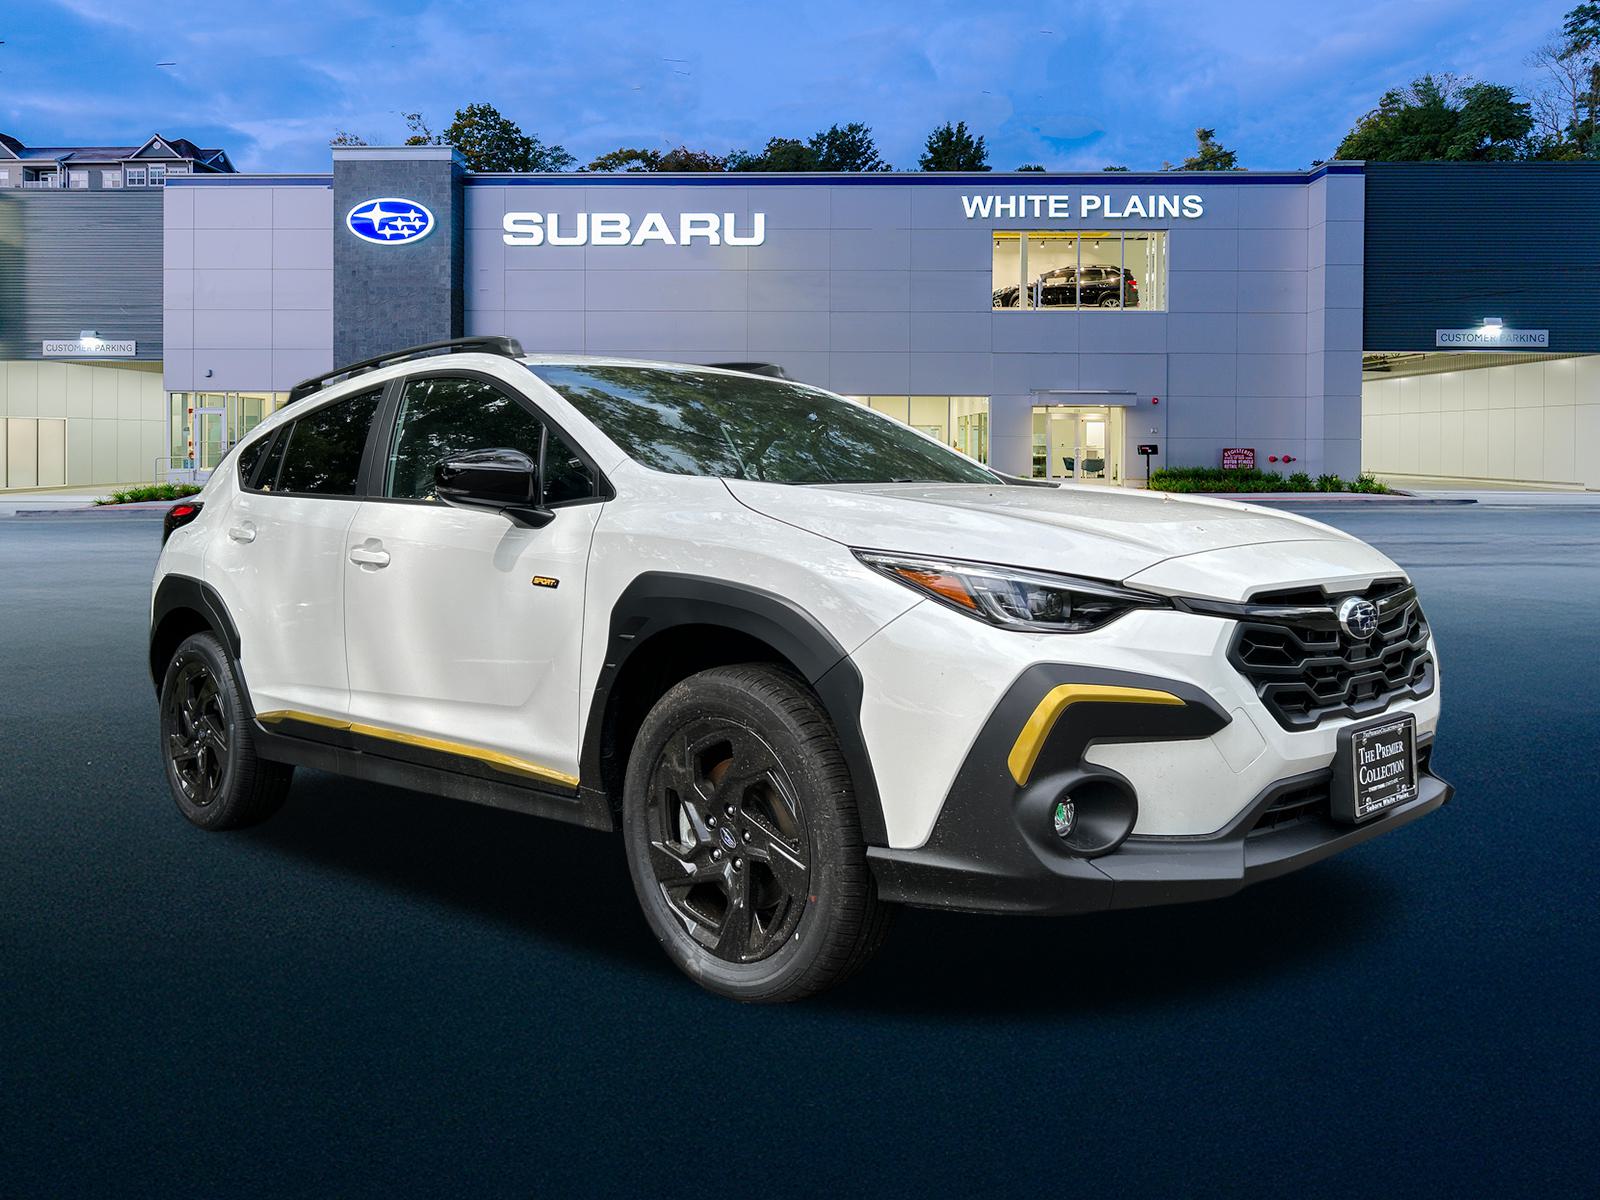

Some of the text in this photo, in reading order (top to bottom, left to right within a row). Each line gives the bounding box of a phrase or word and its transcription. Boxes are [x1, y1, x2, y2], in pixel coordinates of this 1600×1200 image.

[961, 194, 1204, 219] WHITE PLAINS
[502, 212, 765, 246] SUBARU
[45, 344, 133, 353] CUSTOMER PARKING
[1440, 333, 1545, 343] CUSTOMER PARKING
[533, 577, 557, 586] SPORT
[1359, 741, 1404, 765] THE PREMIER
[1359, 759, 1405, 784] COLLECTION
